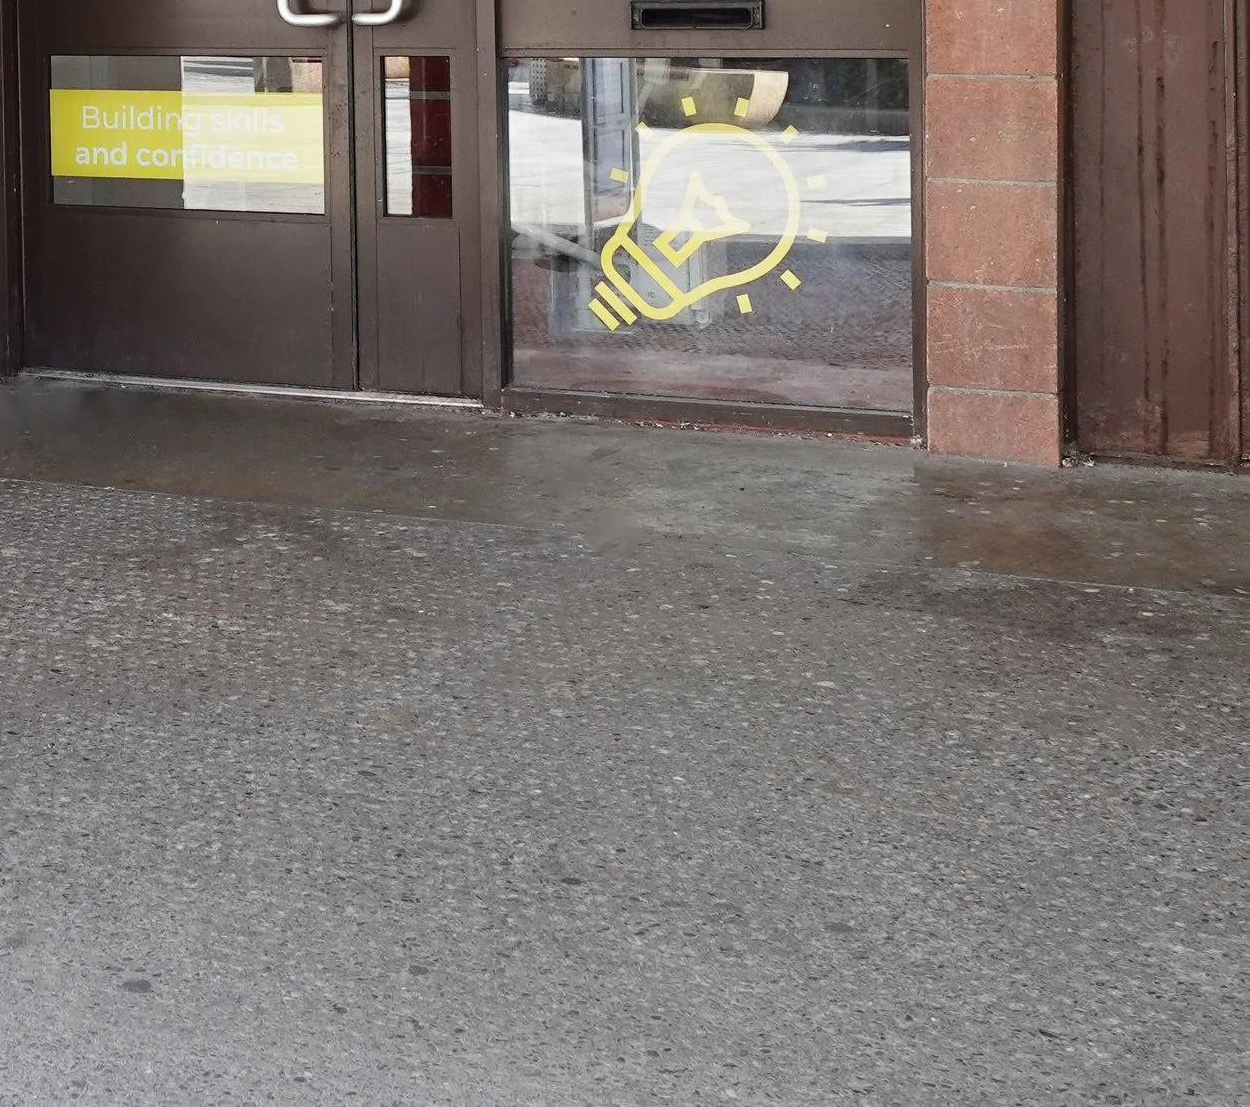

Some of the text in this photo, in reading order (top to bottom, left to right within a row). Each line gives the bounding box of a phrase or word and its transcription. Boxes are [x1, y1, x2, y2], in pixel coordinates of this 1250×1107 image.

[82, 105, 284, 135] Building skills
[75, 142, 300, 170] and confidence
